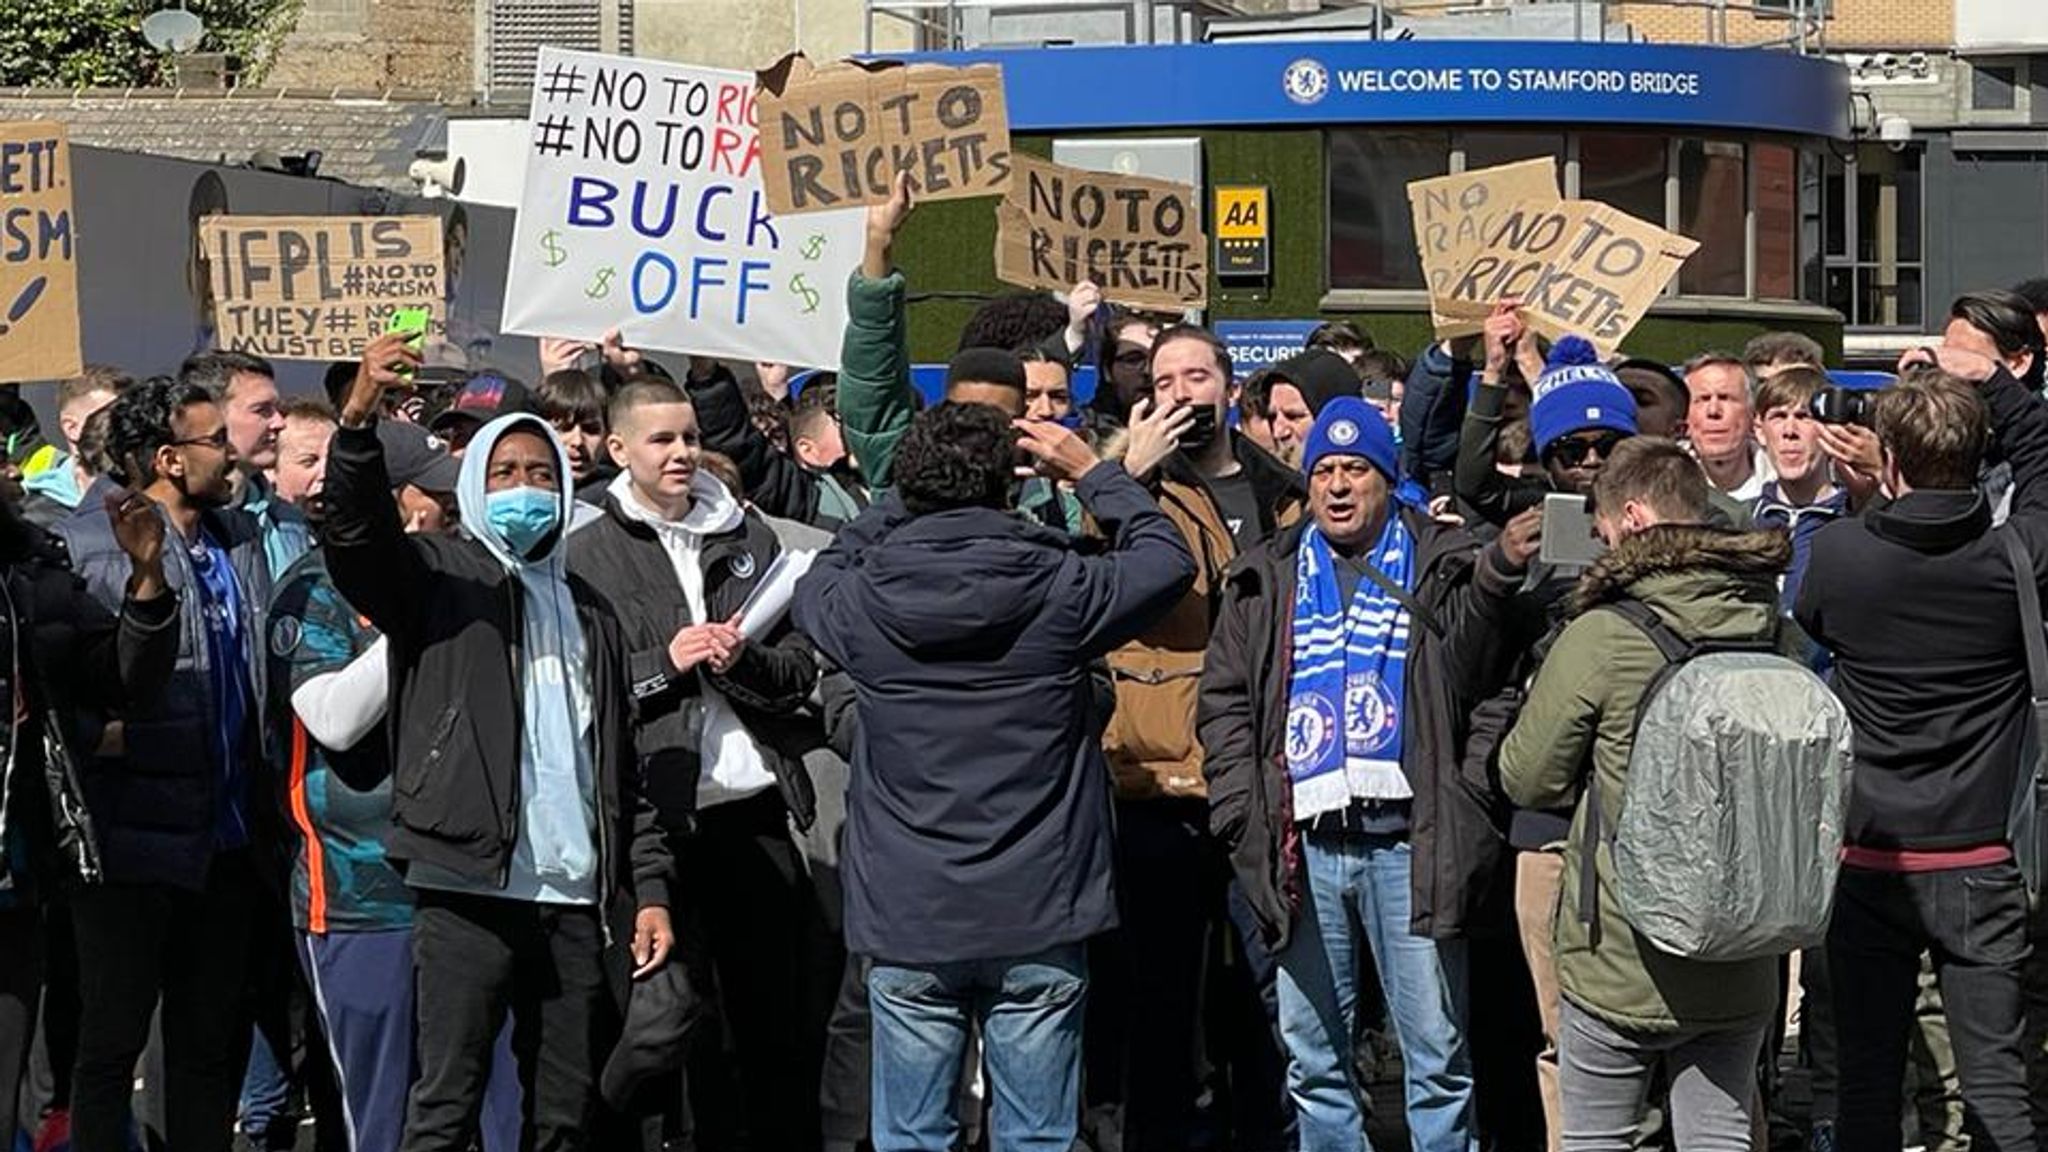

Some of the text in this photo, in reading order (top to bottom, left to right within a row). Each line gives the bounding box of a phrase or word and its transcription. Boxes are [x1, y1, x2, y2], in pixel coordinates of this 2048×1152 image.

[663, 78, 709, 117] TO
[1338, 69, 1700, 96] WELCOME TO STAMFORD BRIDGE
[781, 85, 982, 151] NO TO
[656, 121, 701, 170] TO
[1030, 171, 1184, 237] NO TO
[1224, 201, 1259, 226] AA
[350, 221, 412, 258] IS
[1489, 211, 1645, 277] NO TO
[366, 281, 437, 297] RACISM
[631, 251, 771, 325] OFF
[1451, 256, 1630, 340] RICKETTS
[228, 305, 320, 335] THEY
[230, 336, 322, 356] MUST
